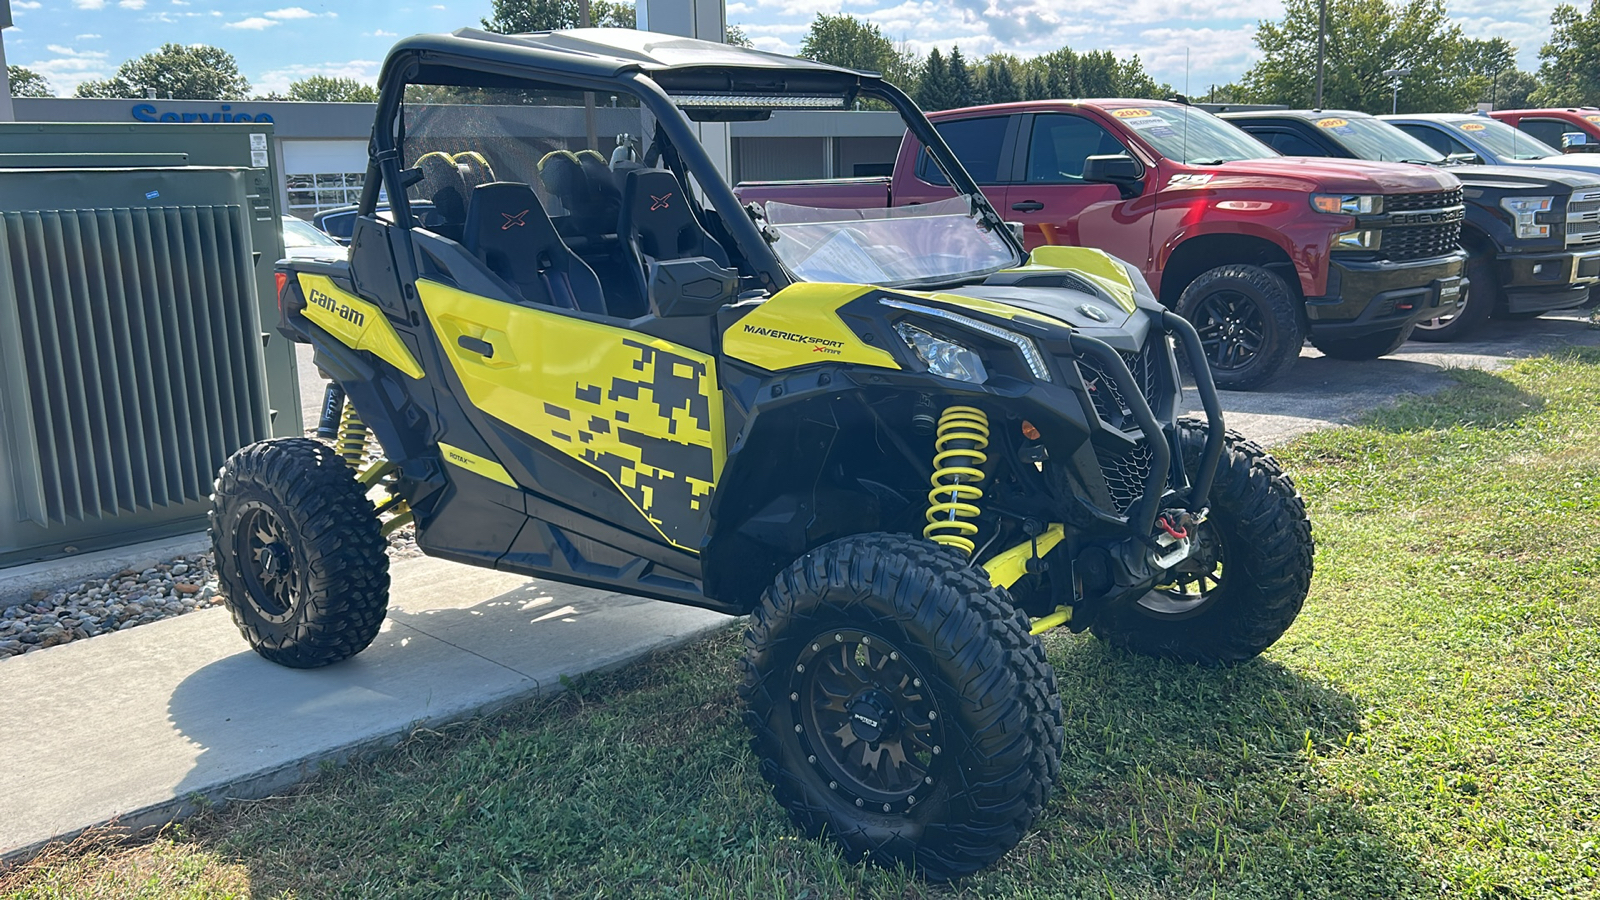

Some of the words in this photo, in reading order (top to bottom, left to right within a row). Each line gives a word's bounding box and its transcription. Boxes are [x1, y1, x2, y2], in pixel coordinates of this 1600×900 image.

[132, 103, 275, 122] Service
[1117, 109, 1148, 117] 2019
[1320, 119, 1343, 127] 2017
[1391, 208, 1465, 225] CHEVROLE
[309, 288, 365, 327] can-am
[743, 324, 808, 344] MAVERICK
[808, 337, 845, 348] SPORT
[449, 451, 468, 464] ROTAX
